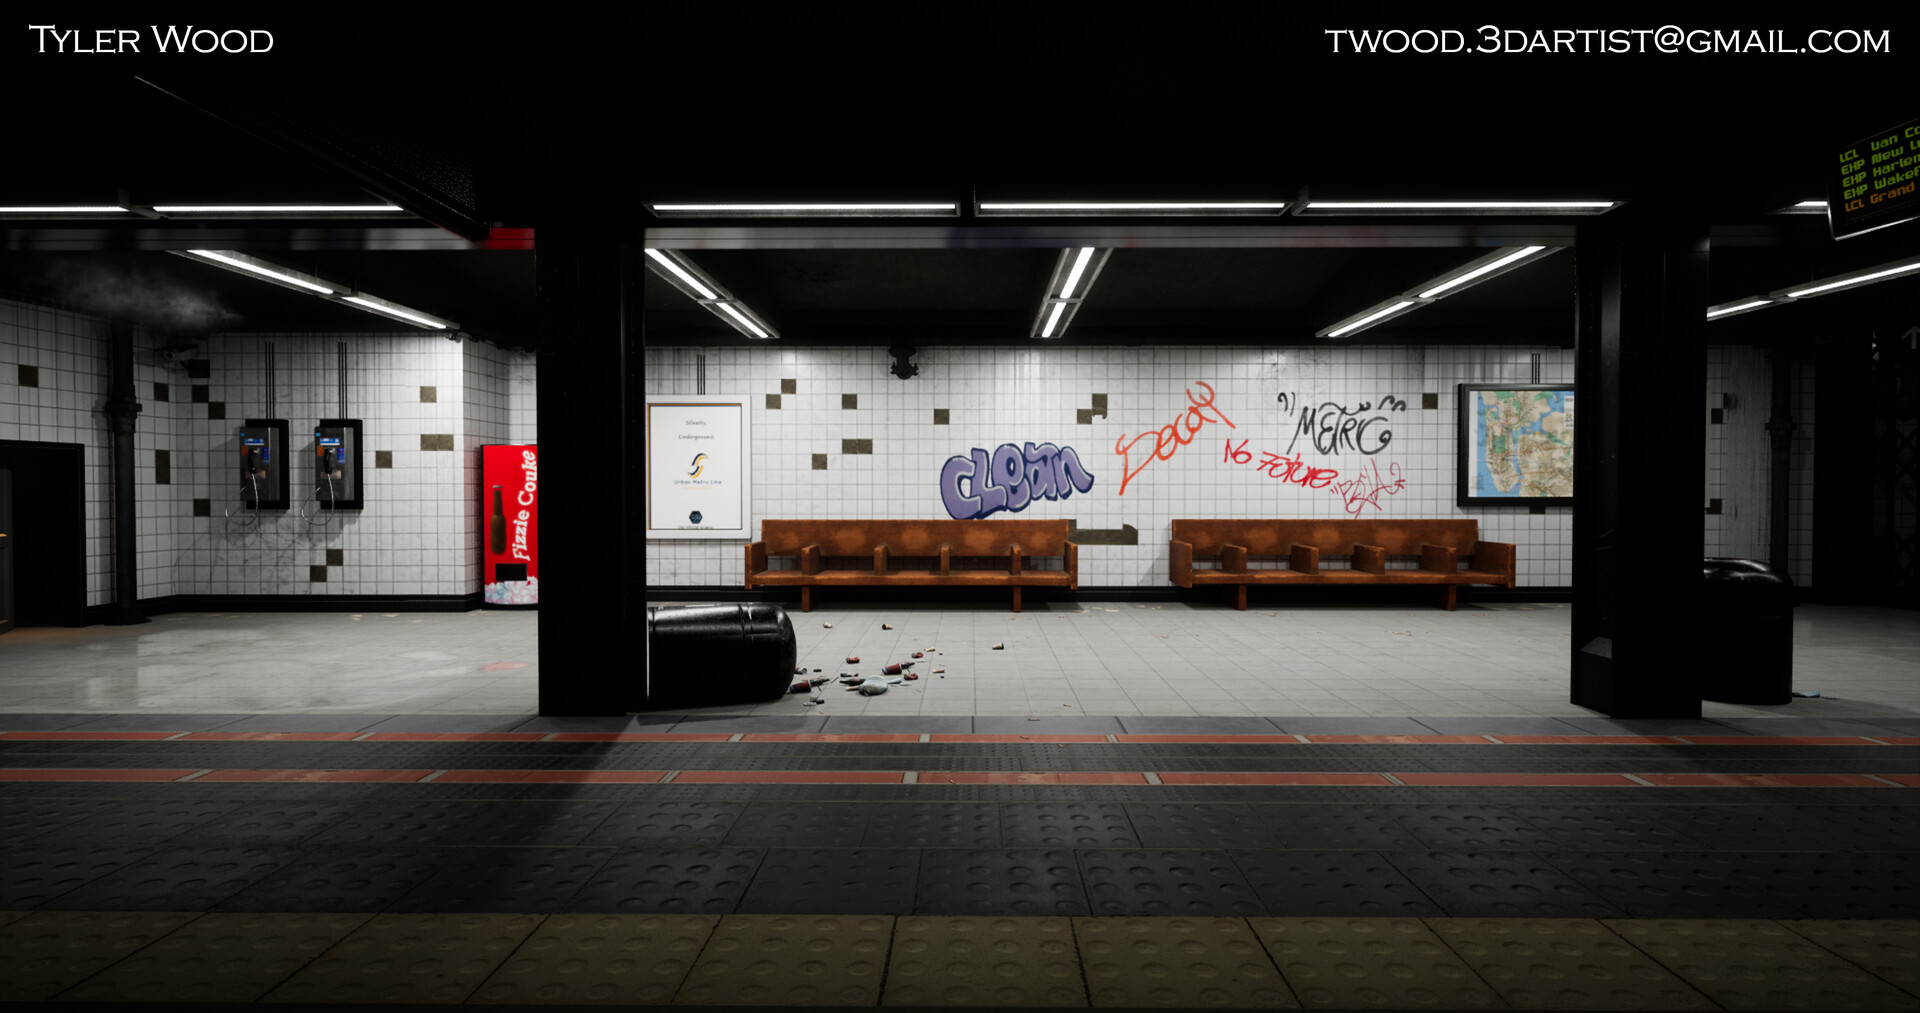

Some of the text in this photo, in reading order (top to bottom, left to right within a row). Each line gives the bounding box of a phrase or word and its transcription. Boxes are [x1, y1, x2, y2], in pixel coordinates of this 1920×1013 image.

[1840, 149, 1859, 163] LCL
[1841, 159, 1866, 175] EHP
[1871, 146, 1904, 164] New
[1842, 171, 1867, 188] EHP
[1843, 184, 1868, 200] EHP
[1845, 181, 1915, 212] LCL Grand
[1223, 438, 1252, 464] No
[512, 450, 538, 561] Fizzie Couke
